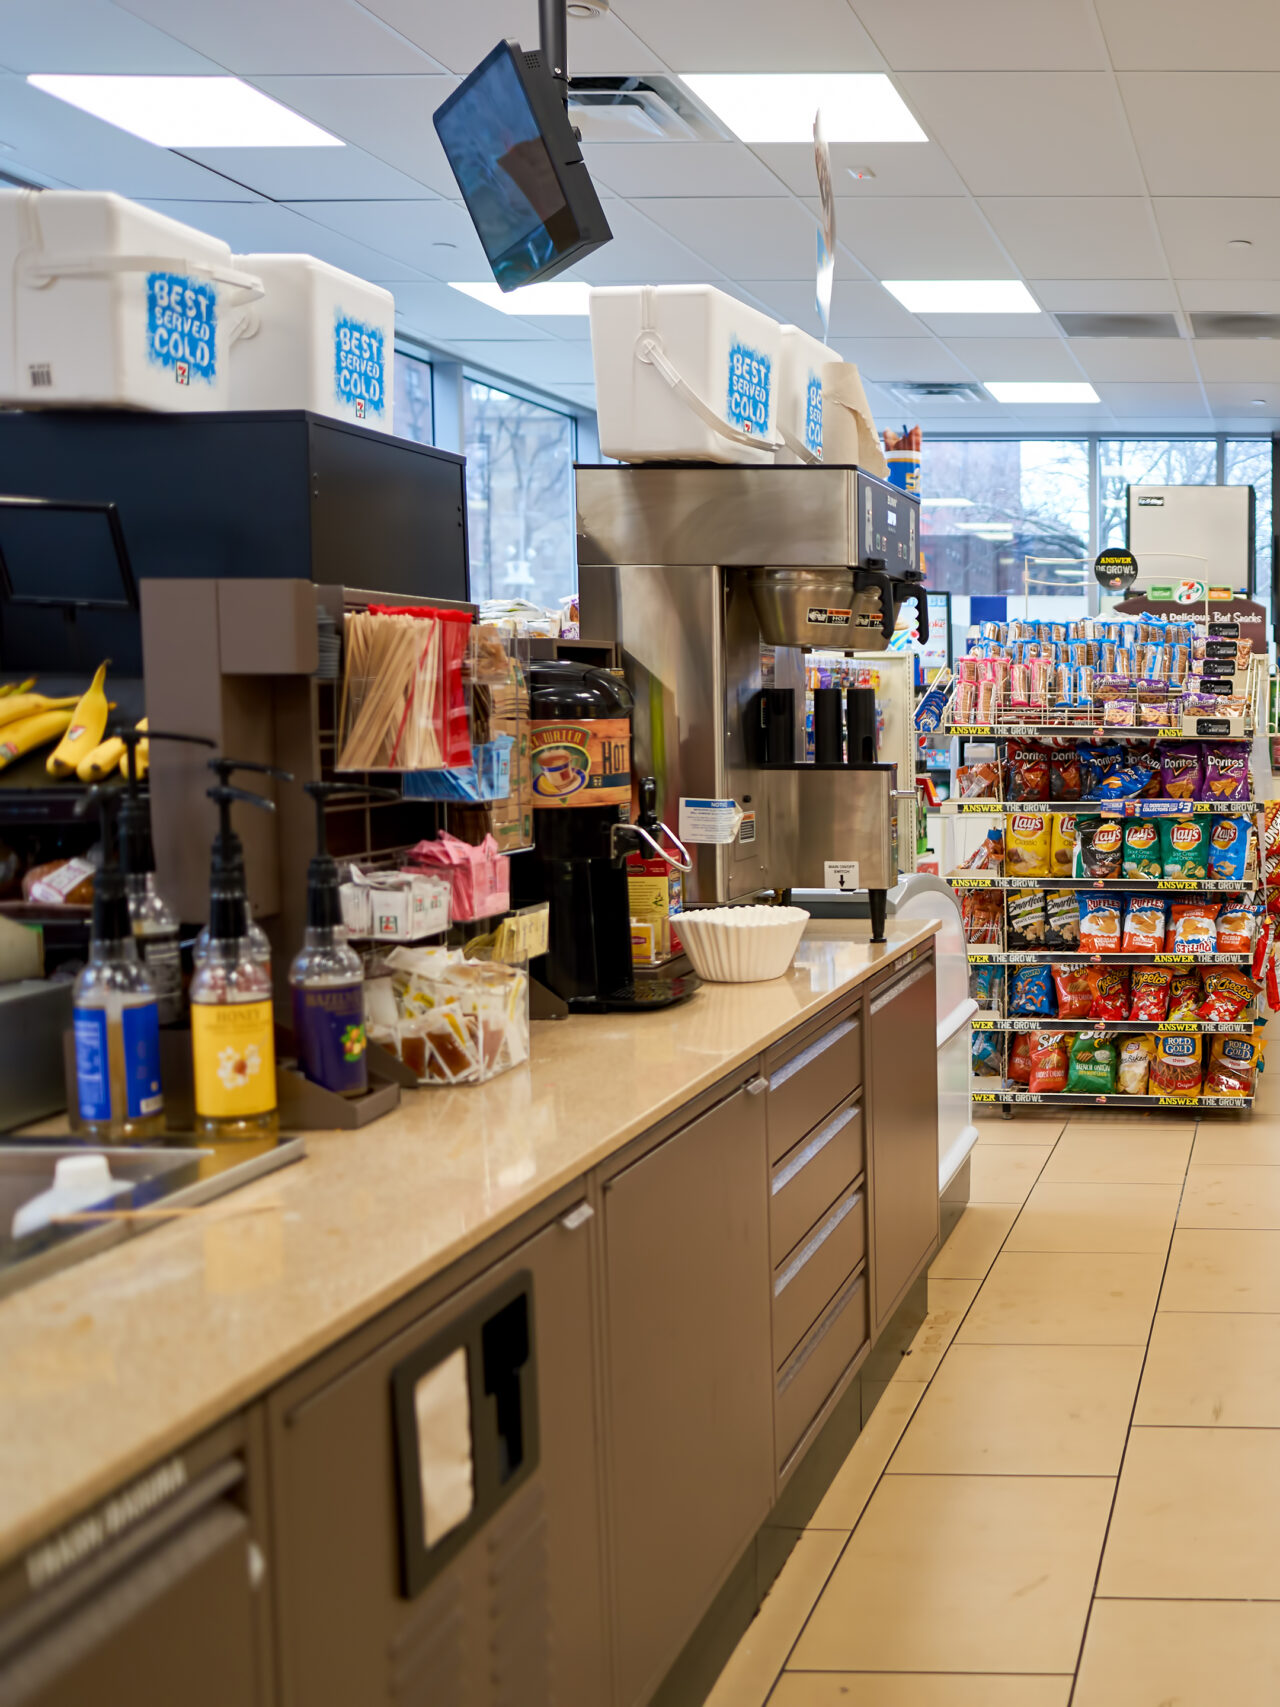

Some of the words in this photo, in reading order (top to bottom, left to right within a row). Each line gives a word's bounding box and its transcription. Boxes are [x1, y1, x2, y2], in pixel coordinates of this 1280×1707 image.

[155, 280, 210, 321] BEST
[155, 306, 210, 341] SERVED
[154, 330, 209, 367] COLD
[340, 328, 379, 361] BEST
[340, 351, 380, 379] SERVED
[734, 354, 766, 386] BEST
[340, 370, 380, 401] COLD
[732, 375, 766, 402] SERVED
[810, 386, 822, 410] BE
[732, 392, 764, 424] COLD
[808, 421, 822, 443] CO
[1106, 565, 1136, 575] GROWL
[1160, 614, 1168, 622] &
[1170, 613, 1210, 622] Delicious
[1232, 612, 1262, 623] Snacks
[950, 726, 990, 734] ANSWER
[543, 730, 582, 744] WATER
[1014, 750, 1048, 760] Doritos
[1164, 758, 1198, 768] Doritos
[1208, 756, 1244, 768] Doritos
[1005, 804, 1021, 812] THE
[1023, 804, 1051, 812] GROWL
[1178, 802, 1192, 812] $3
[1214, 803, 1230, 812] THE
[1232, 803, 1260, 812] GROWL
[1014, 817, 1042, 832] Lay's
[1094, 828, 1122, 844] Lay's
[1173, 828, 1200, 842] Lay's
[1212, 826, 1236, 840] Lay's
[1200, 882, 1216, 890] THE
[1218, 882, 1246, 890] GROWL
[1087, 898, 1121, 910] RUFFLES
[1130, 898, 1164, 910] RUFFLES
[1224, 903, 1256, 912] RUFFLES
[1218, 978, 1253, 1000] Cheetos
[1168, 1037, 1192, 1046] ROLD
[1228, 1041, 1250, 1050] ROLD
[1166, 1045, 1192, 1054] GOLD
[1225, 1049, 1251, 1059] GOLD
[1000, 1094, 1014, 1102] THE
[1016, 1094, 1044, 1102] GROWL
[1202, 1098, 1216, 1106] THE
[1218, 1098, 1246, 1106] GROWL
